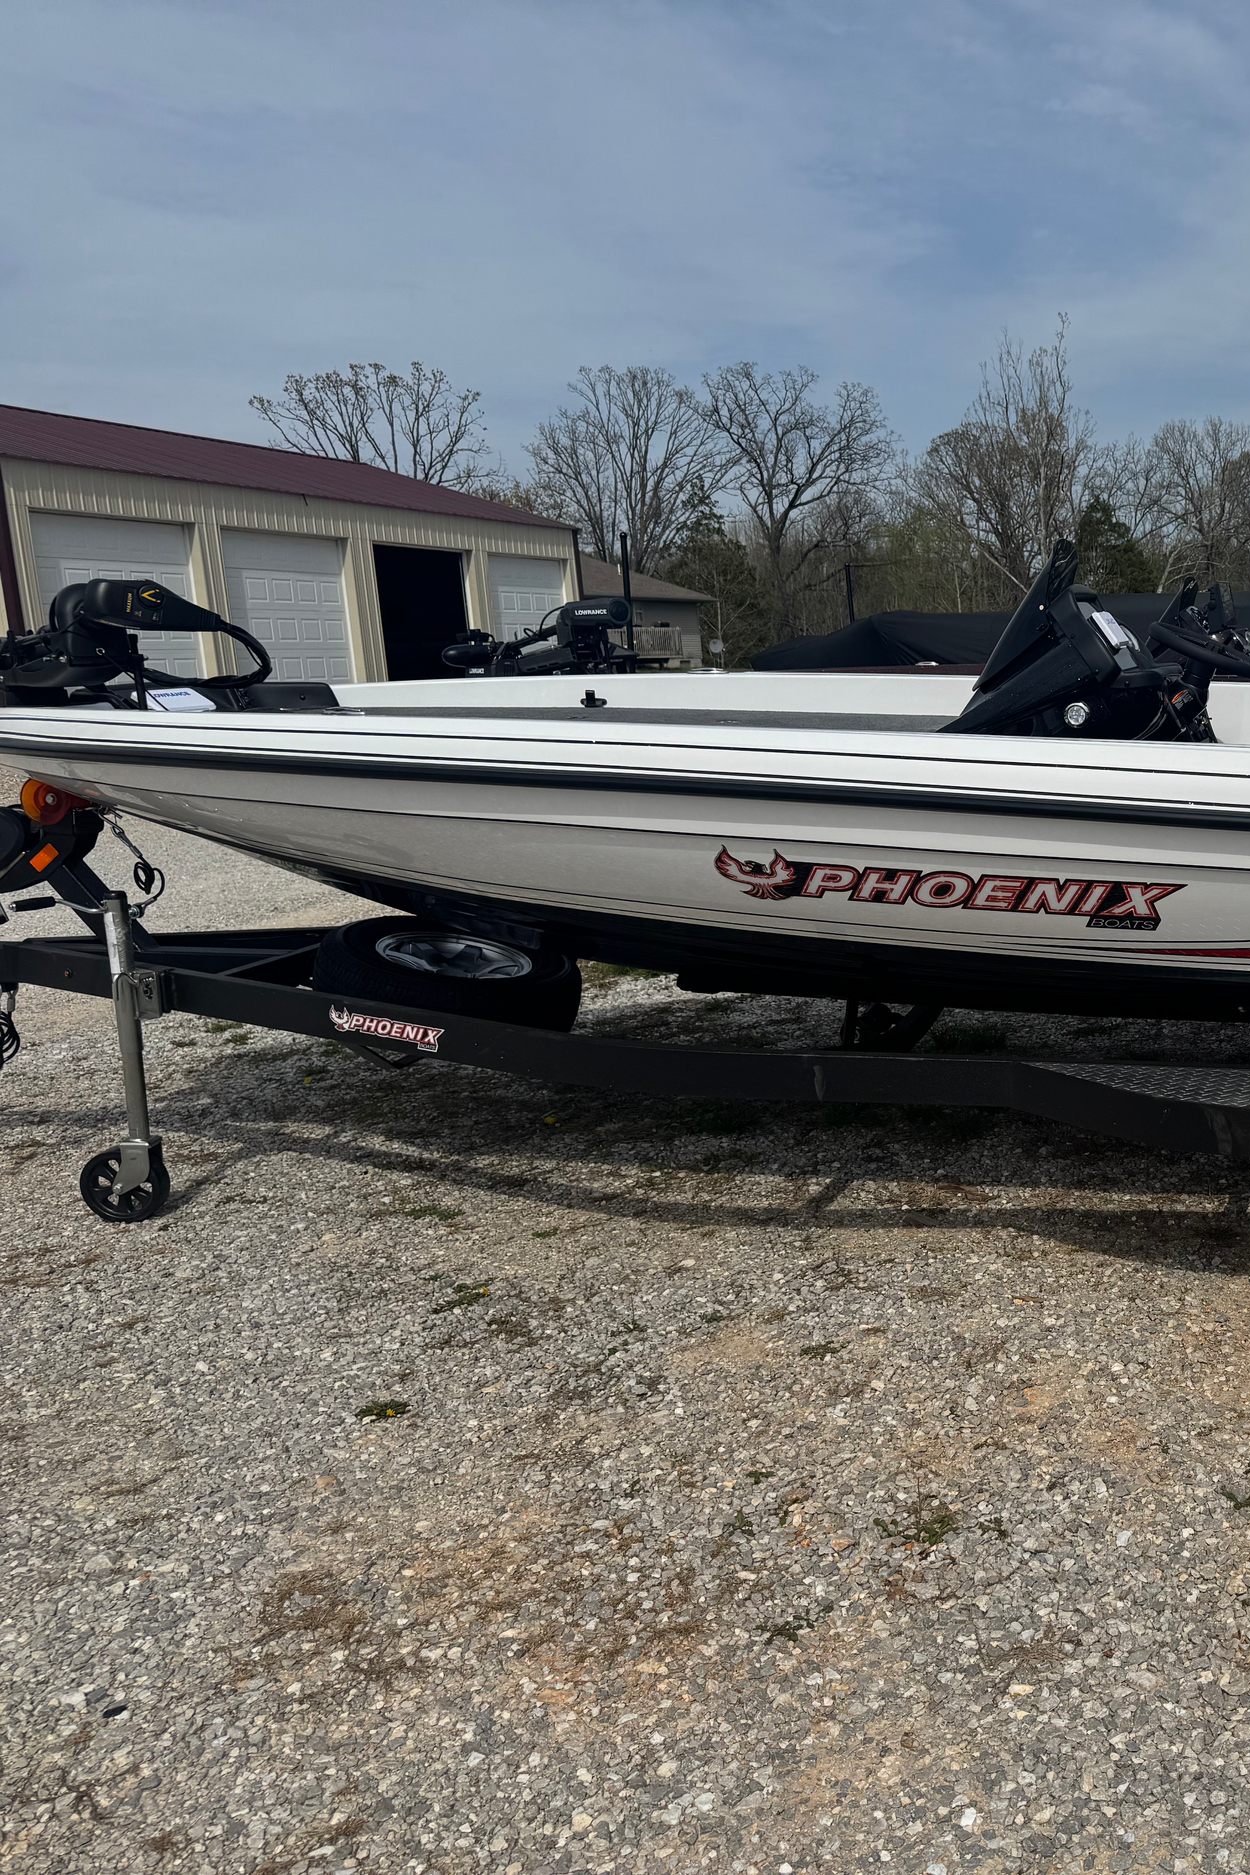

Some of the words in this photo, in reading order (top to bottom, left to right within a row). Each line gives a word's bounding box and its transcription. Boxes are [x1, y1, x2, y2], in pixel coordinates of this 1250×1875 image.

[574, 608, 607, 616] LOWRANCE
[800, 865, 1185, 919] PHOENIX
[1091, 918, 1155, 930] BOATS
[349, 1014, 442, 1045] PHOENIX
